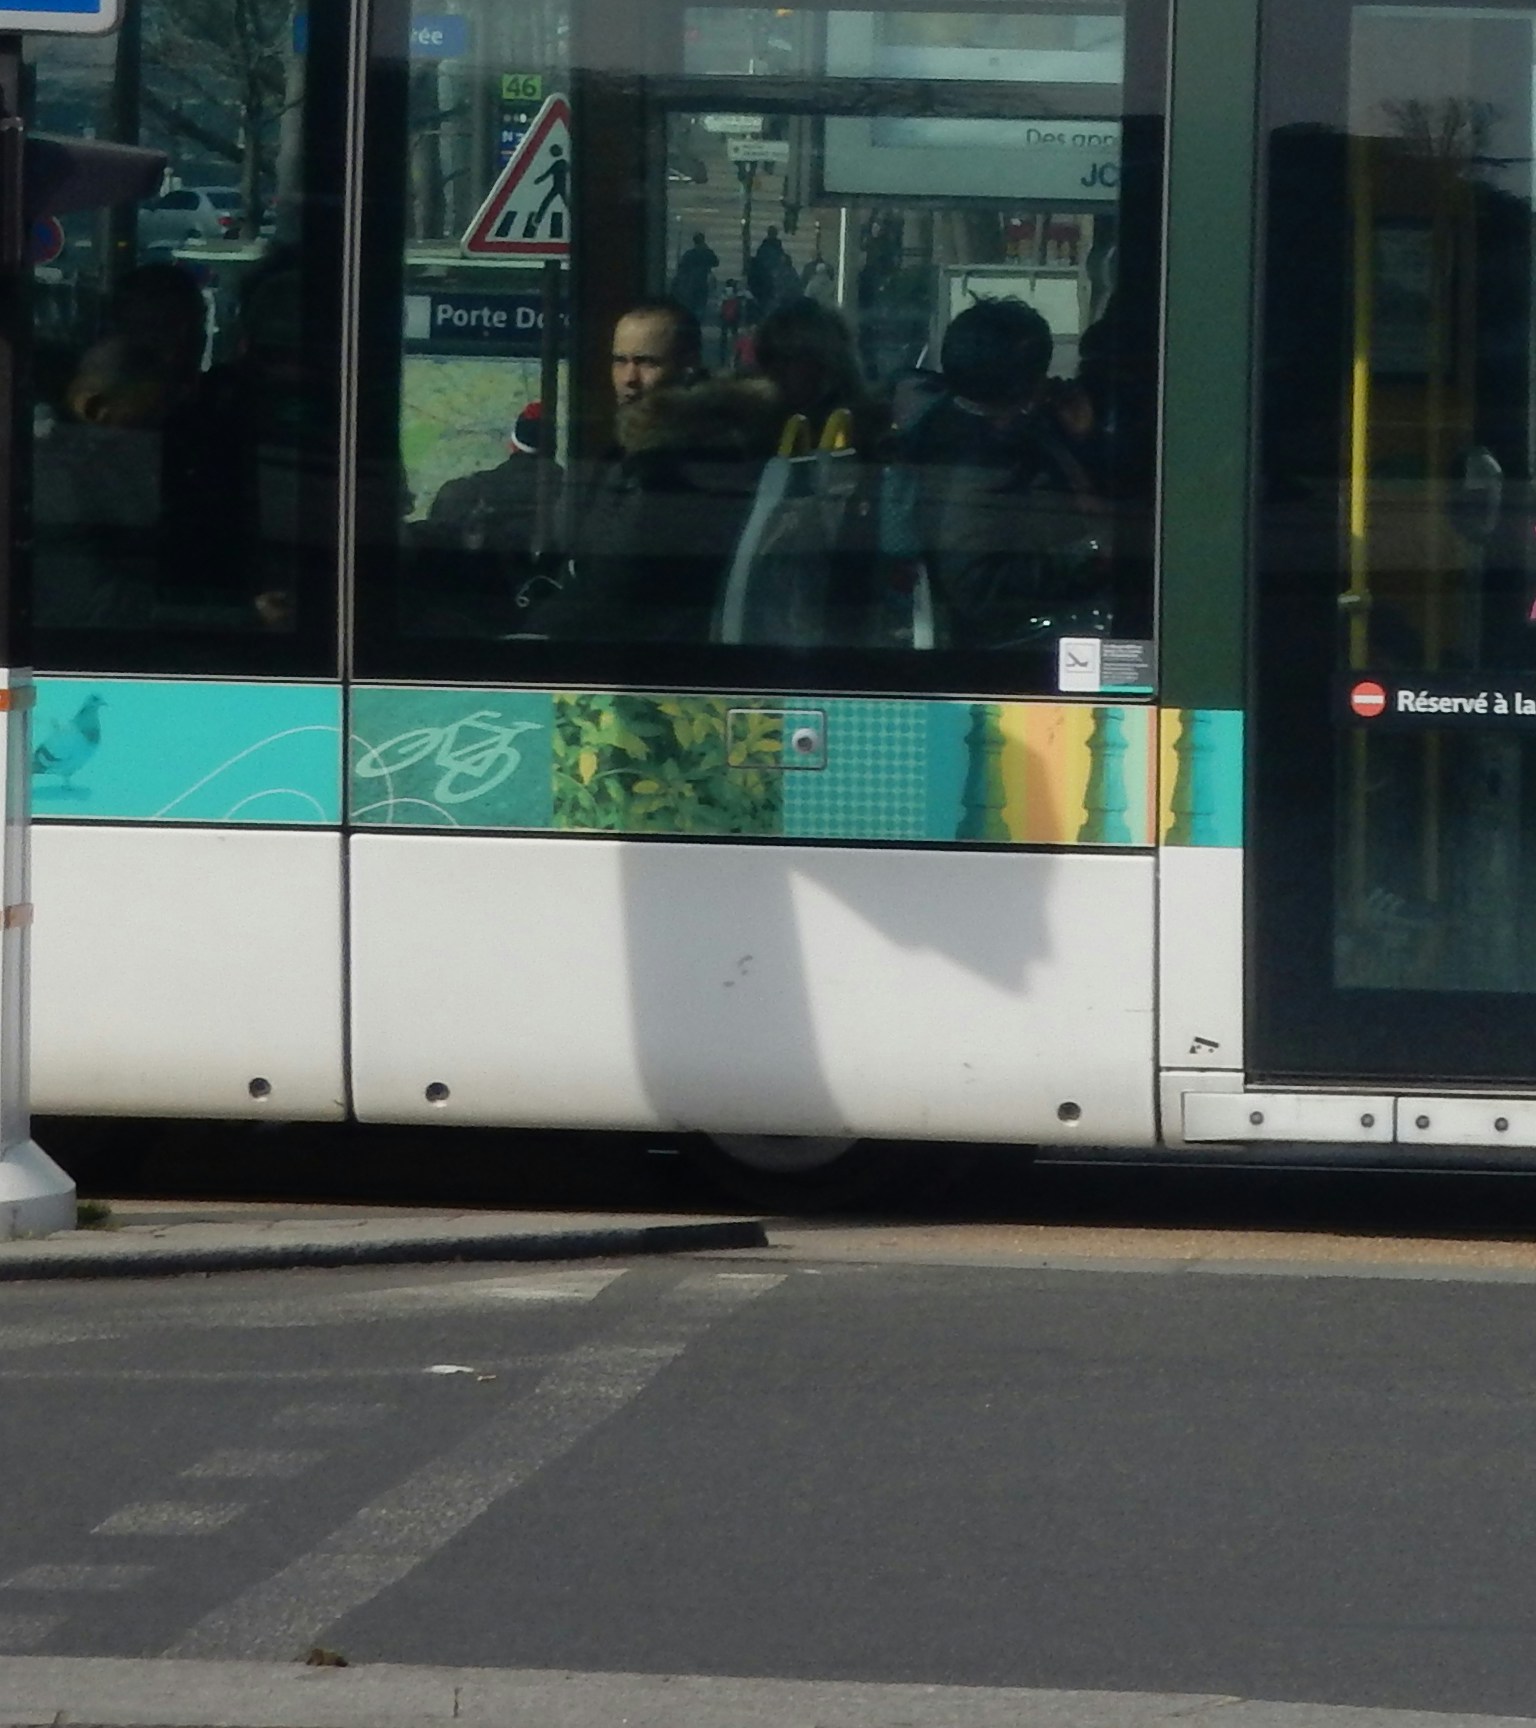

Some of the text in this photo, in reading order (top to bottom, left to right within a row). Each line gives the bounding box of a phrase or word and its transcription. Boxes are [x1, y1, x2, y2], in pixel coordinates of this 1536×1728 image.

[506, 76, 537, 97] 46
[436, 304, 508, 329] Porte
[1397, 690, 1488, 714] Réservé
[1493, 692, 1509, 714] à
[1515, 692, 1536, 715] la
